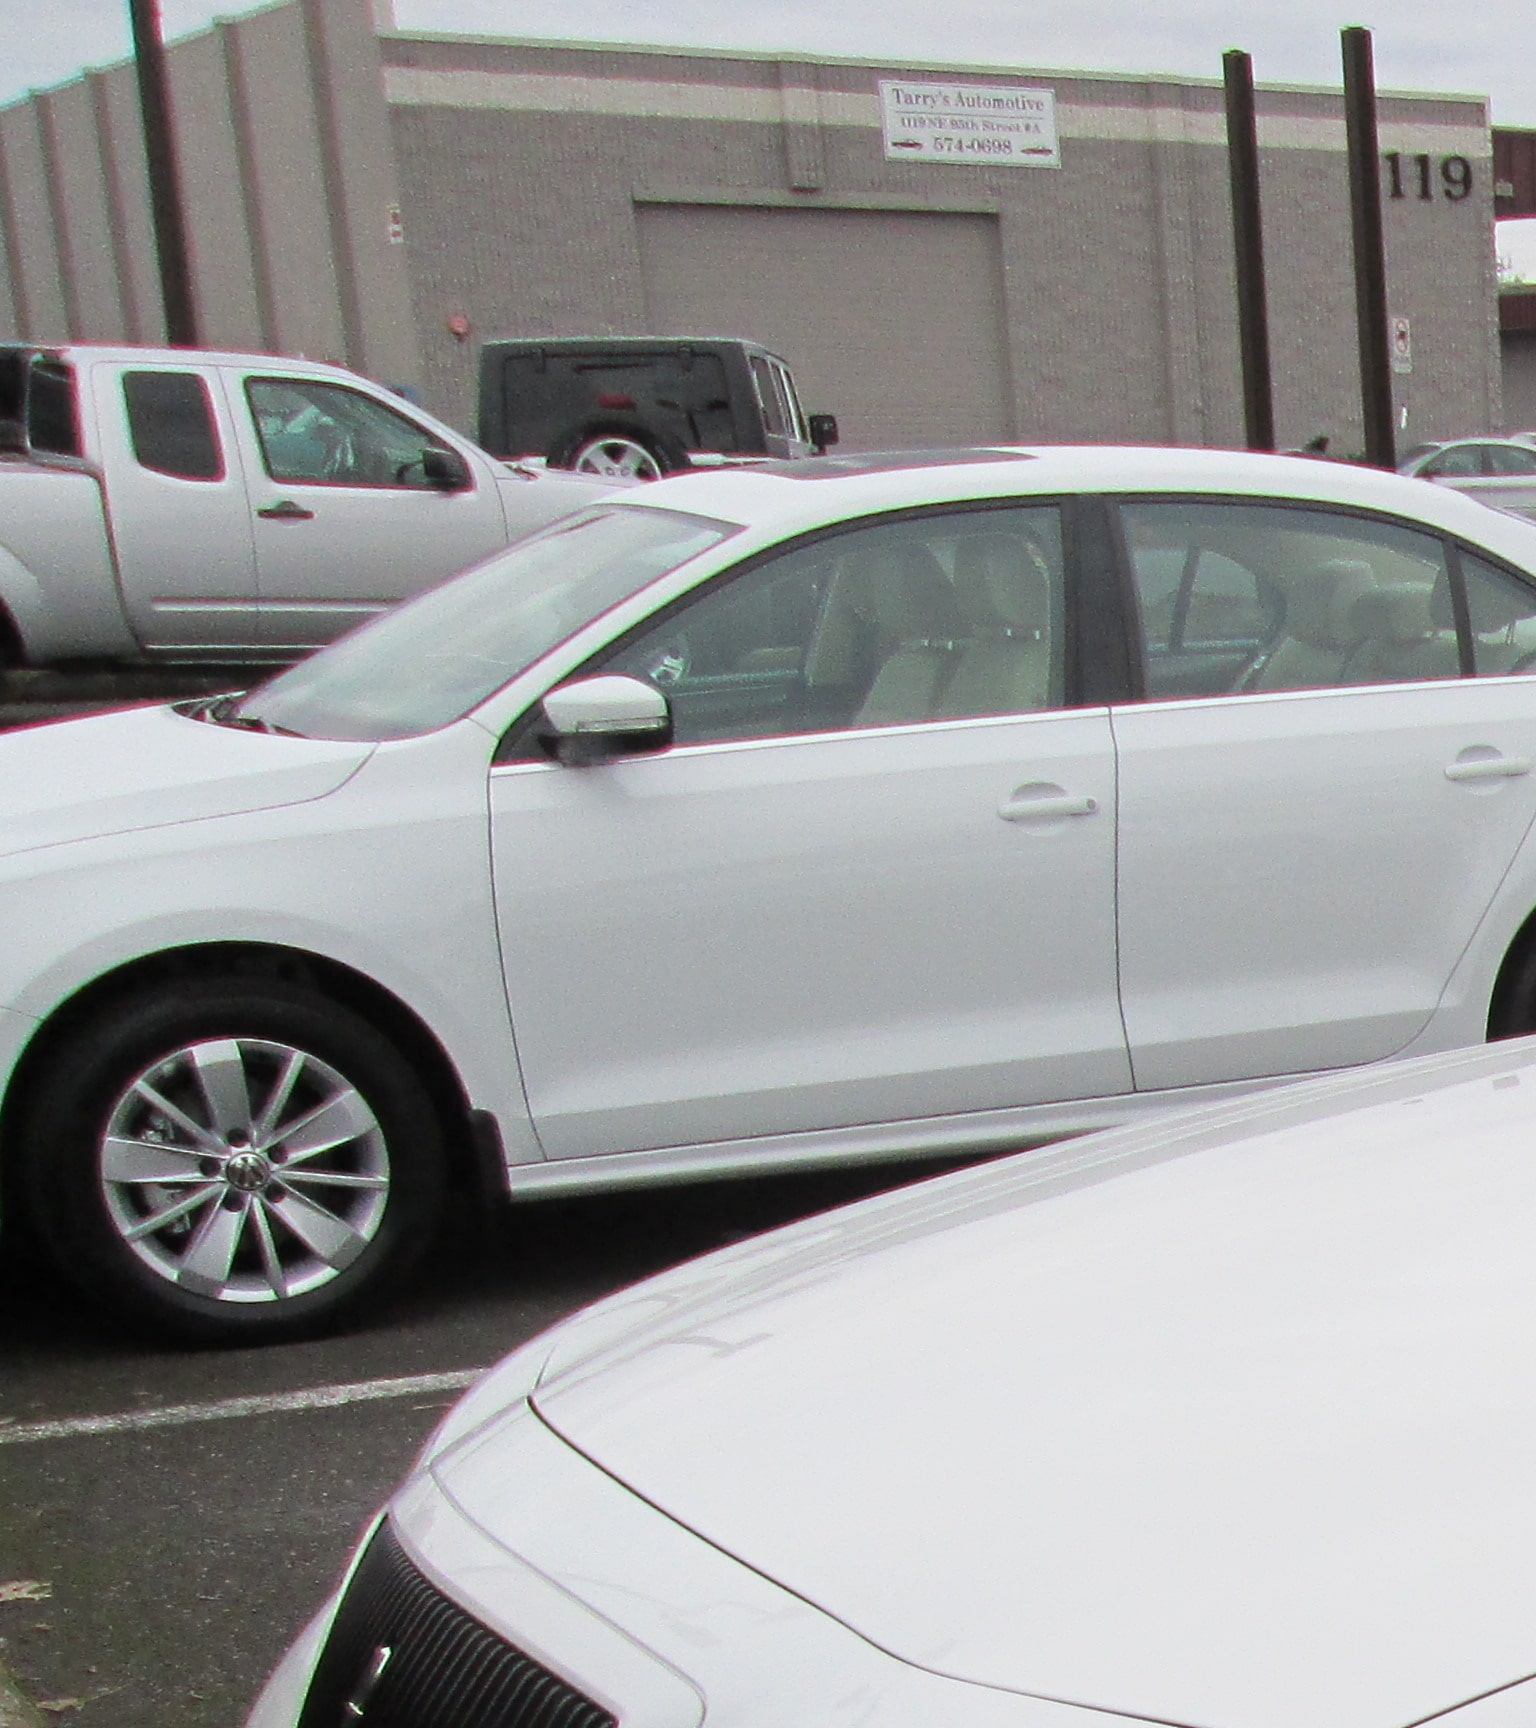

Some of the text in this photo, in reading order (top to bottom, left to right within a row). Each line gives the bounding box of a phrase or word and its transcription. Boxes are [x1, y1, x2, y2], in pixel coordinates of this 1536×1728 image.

[891, 87, 1045, 112] Tarry's Automotive
[982, 119, 1021, 133] Street
